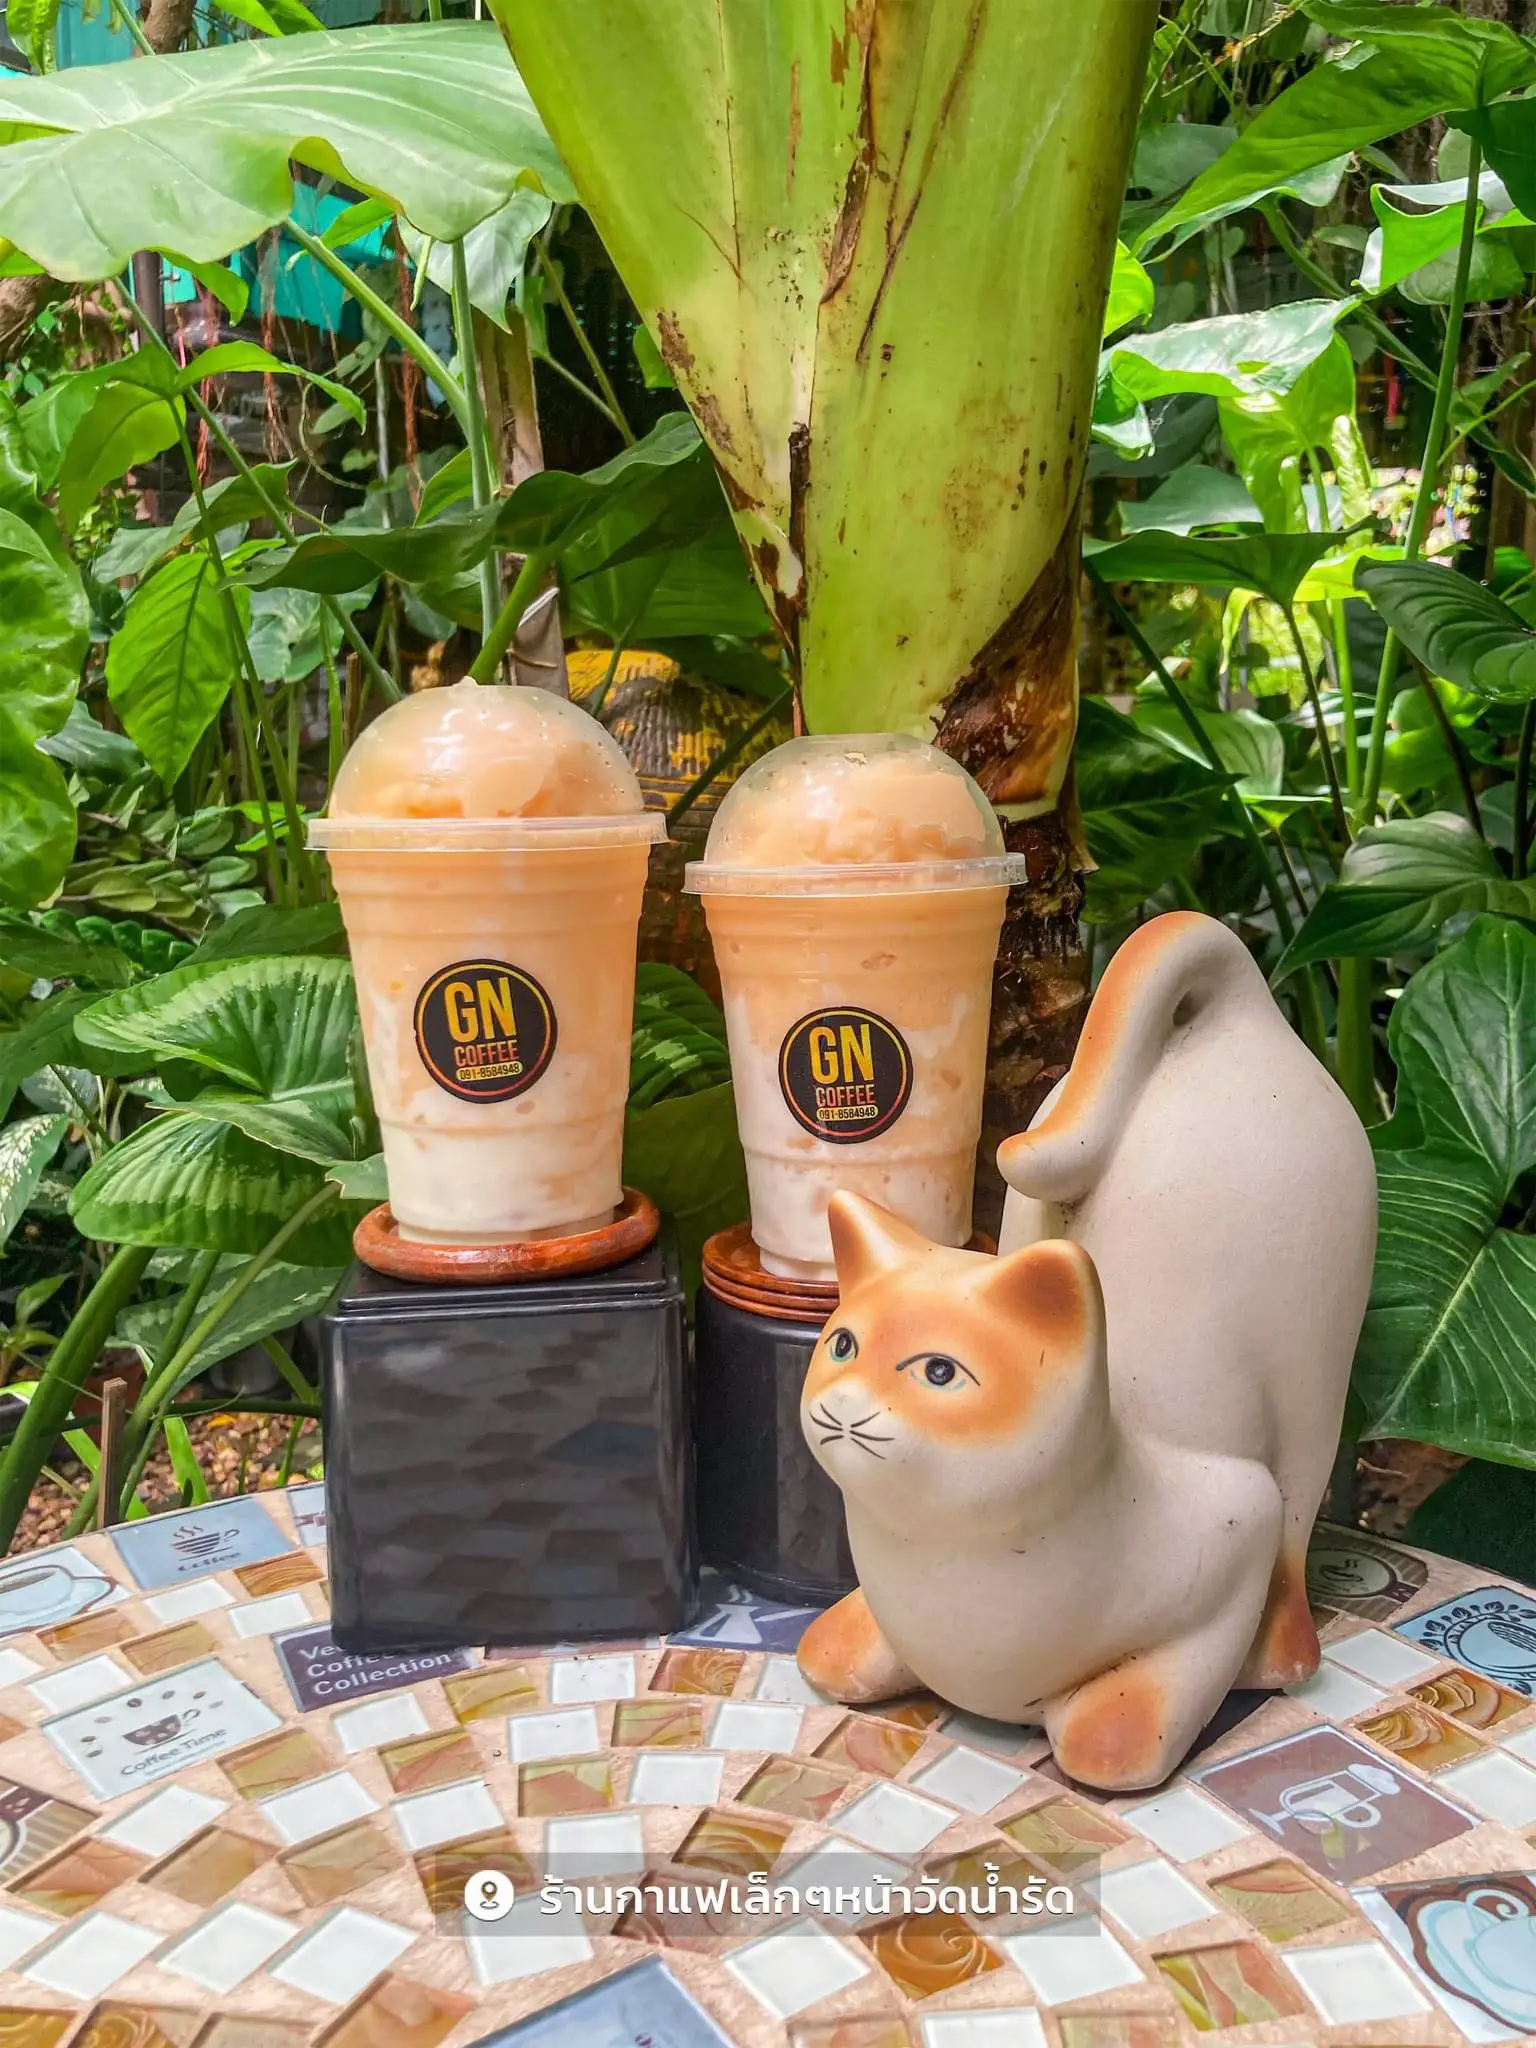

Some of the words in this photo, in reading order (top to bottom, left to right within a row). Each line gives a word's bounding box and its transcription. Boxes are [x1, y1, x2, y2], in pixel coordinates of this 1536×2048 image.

[444, 976, 518, 1043] GN
[454, 1039, 520, 1067] COFFEE
[808, 1023, 875, 1085] GN
[459, 1062, 521, 1080] 091-8584948
[815, 1084, 877, 1107] COFFEE
[819, 1106, 876, 1120] 091-8584948
[314, 1653, 453, 1695] Collection
[120, 1747, 181, 1776] Coffee
[178, 1727, 227, 1750] Time
